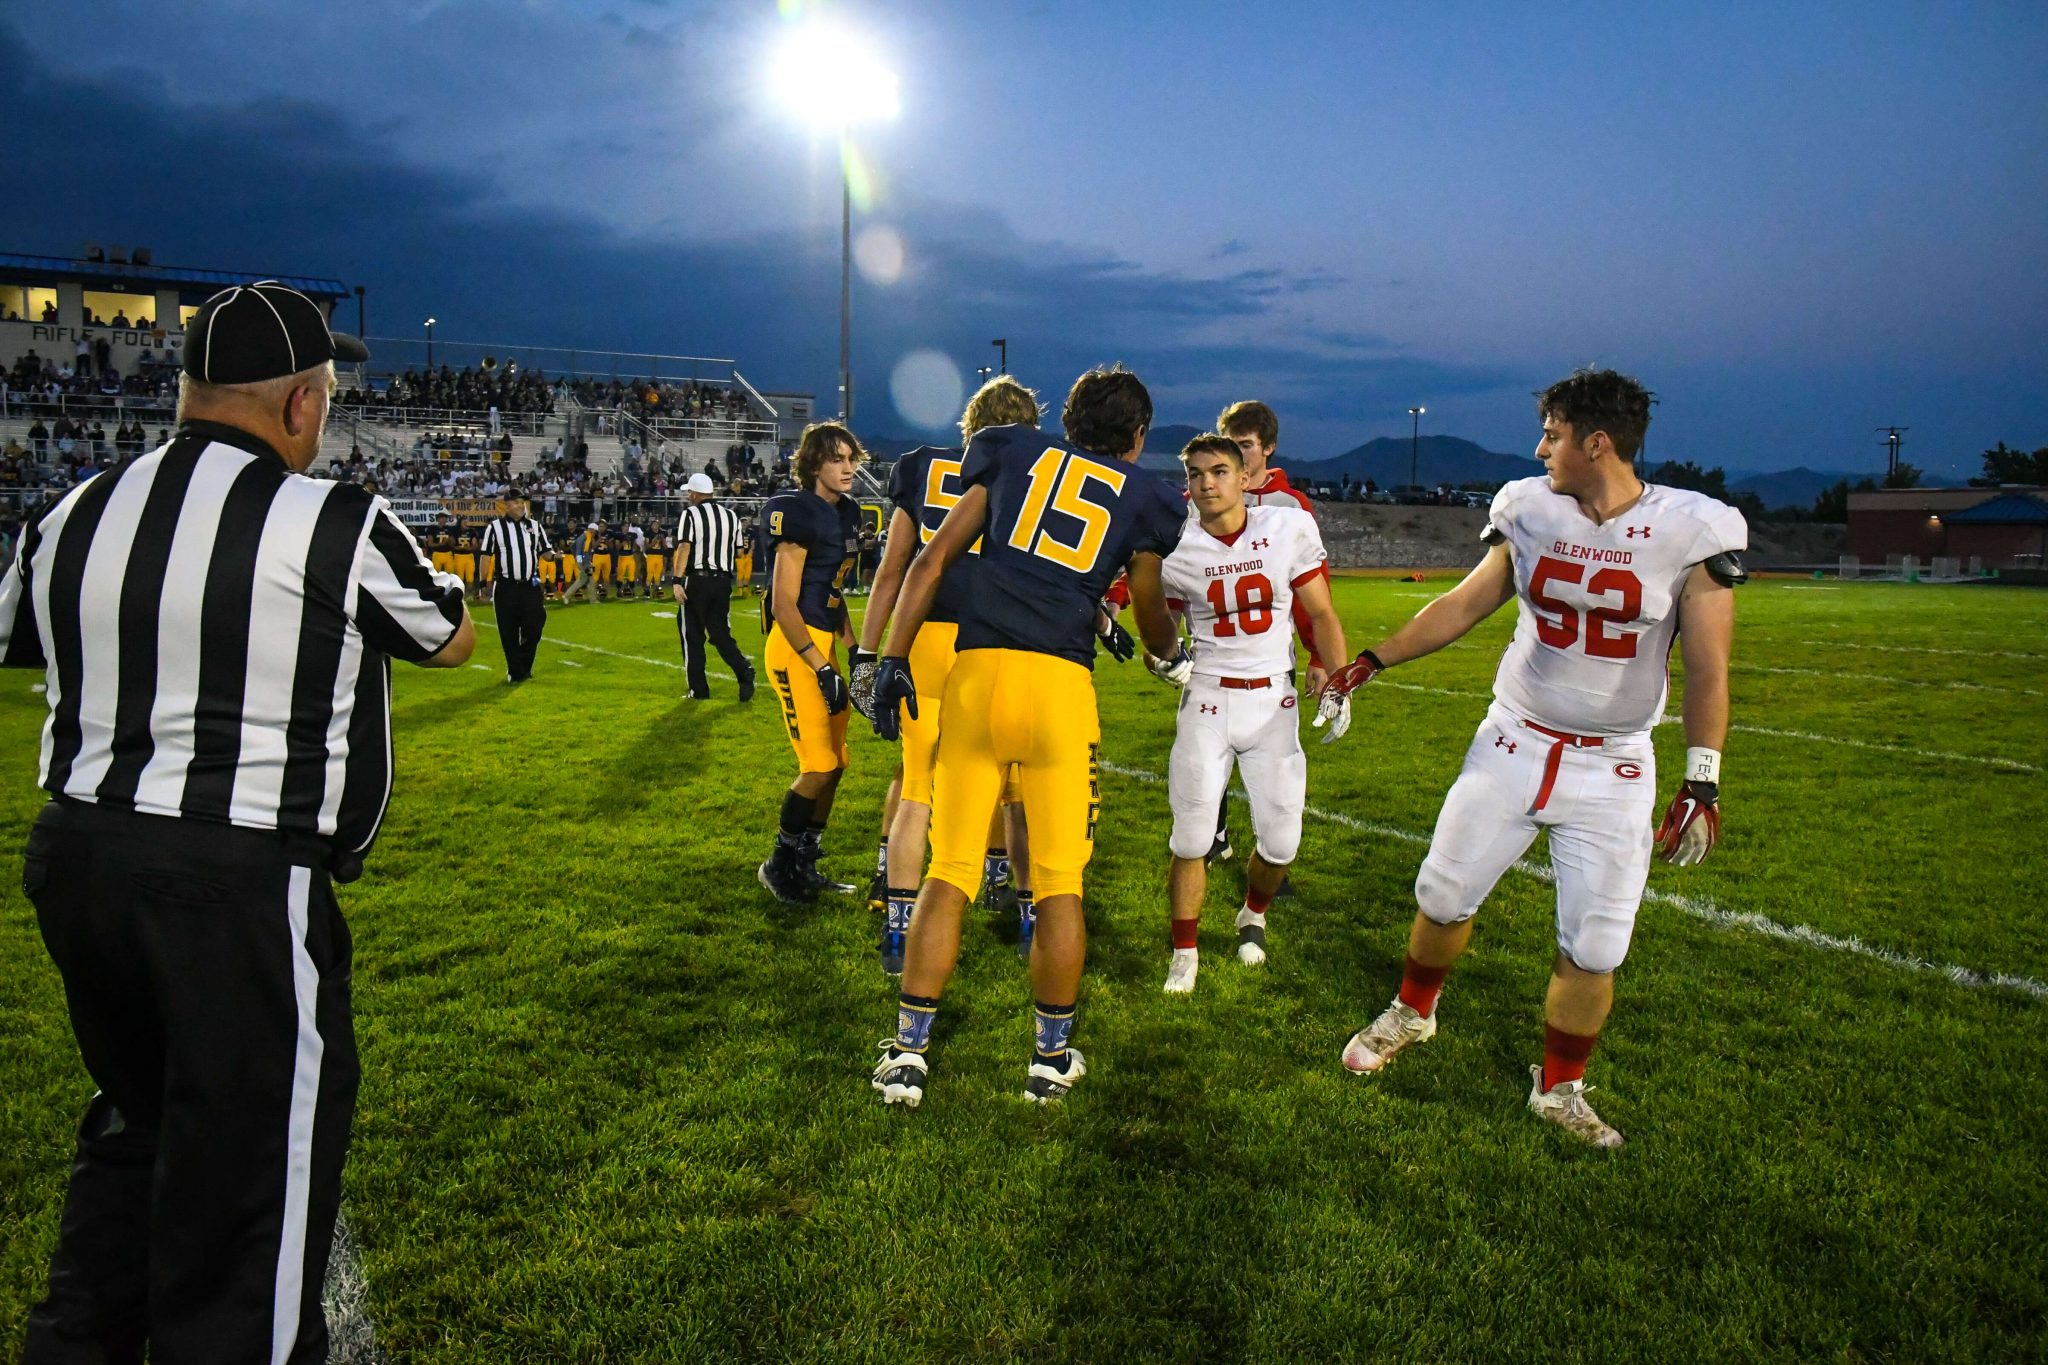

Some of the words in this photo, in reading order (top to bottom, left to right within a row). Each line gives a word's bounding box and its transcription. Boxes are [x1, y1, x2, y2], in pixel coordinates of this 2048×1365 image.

[390, 500, 414, 511] roud
[415, 500, 444, 511] Home
[474, 501, 496, 511] 2021
[1008, 446, 1127, 574] 15
[770, 511, 784, 536] 9
[1553, 541, 1633, 565] GLENWOOD
[1204, 559, 1263, 577] GLENWOOD
[1529, 555, 1643, 658] 52
[1613, 762, 1643, 780] G
